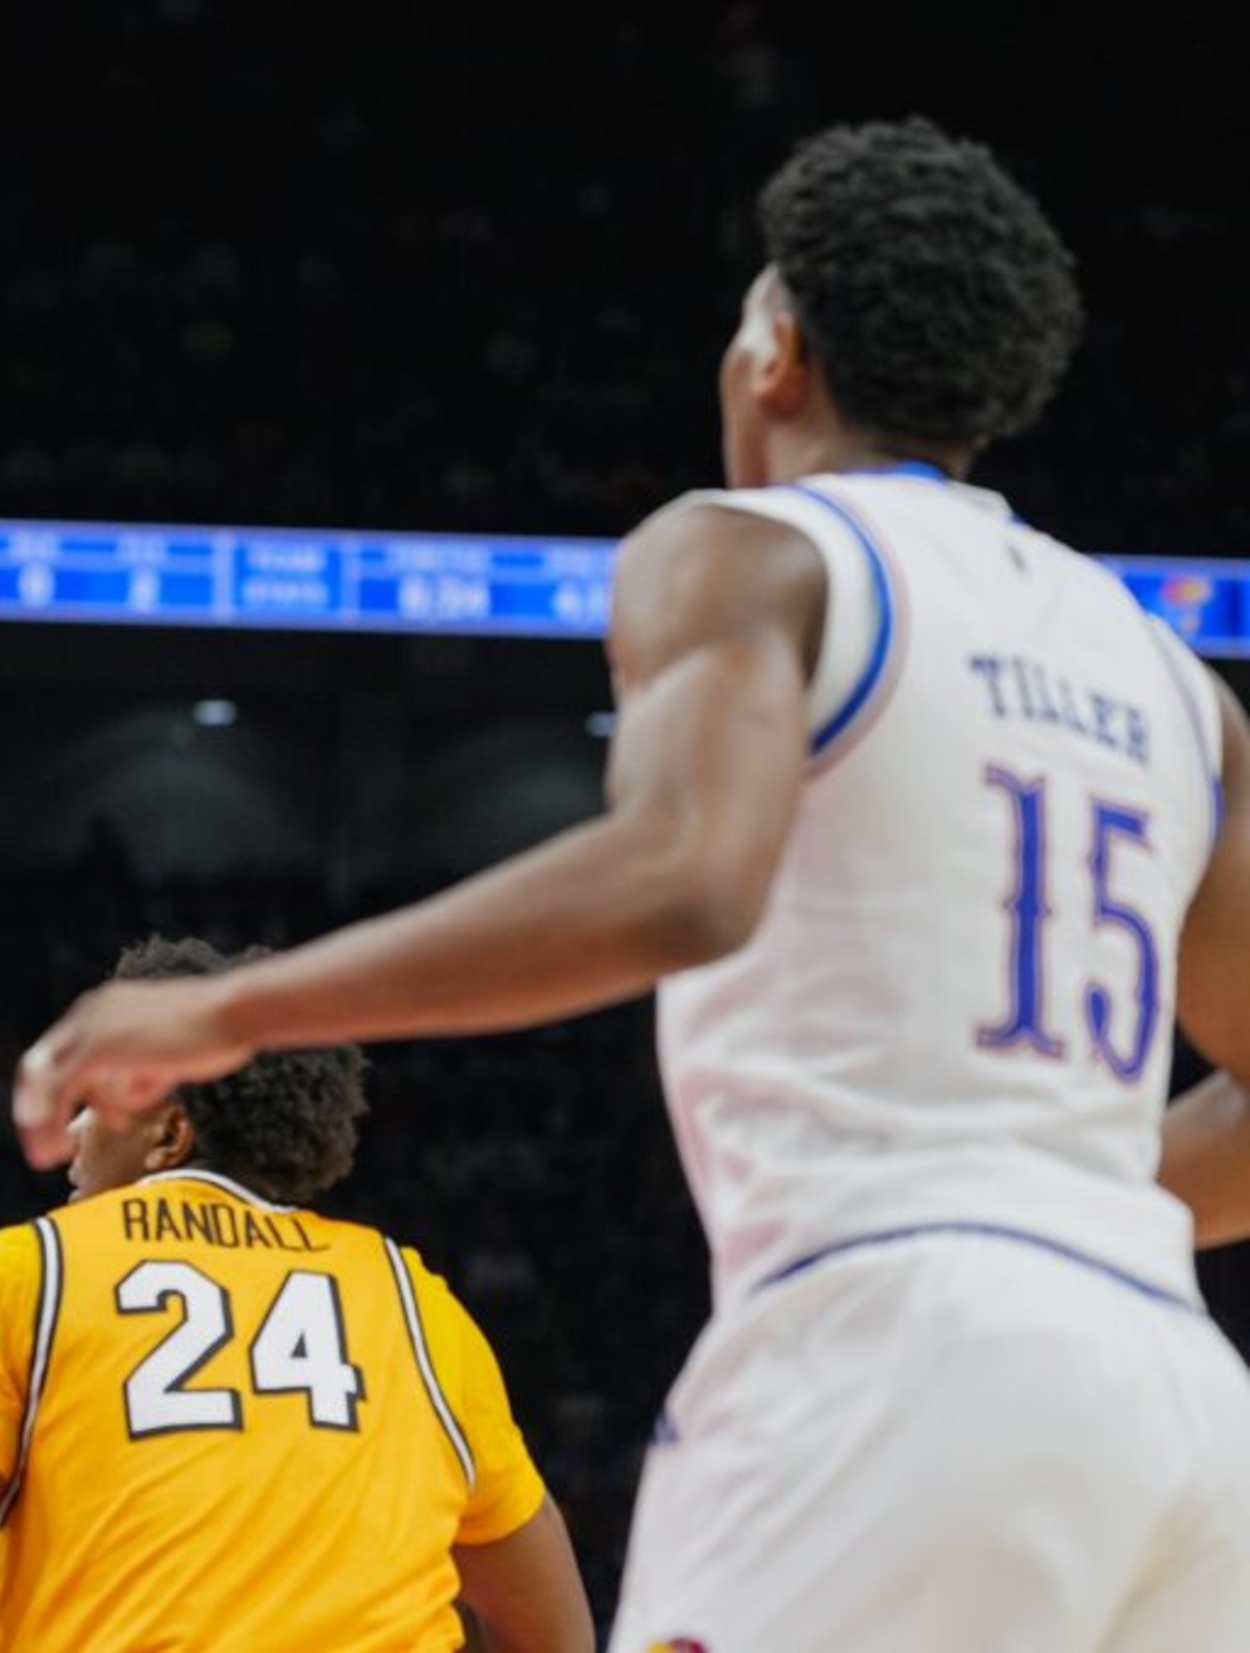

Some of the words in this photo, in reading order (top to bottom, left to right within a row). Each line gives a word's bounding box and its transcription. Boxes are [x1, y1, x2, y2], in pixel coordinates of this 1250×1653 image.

[968, 650, 1151, 766] TILLER
[974, 761, 1159, 1084] 15
[121, 1197, 331, 1253] RANDALL
[113, 1258, 368, 1443] 24
